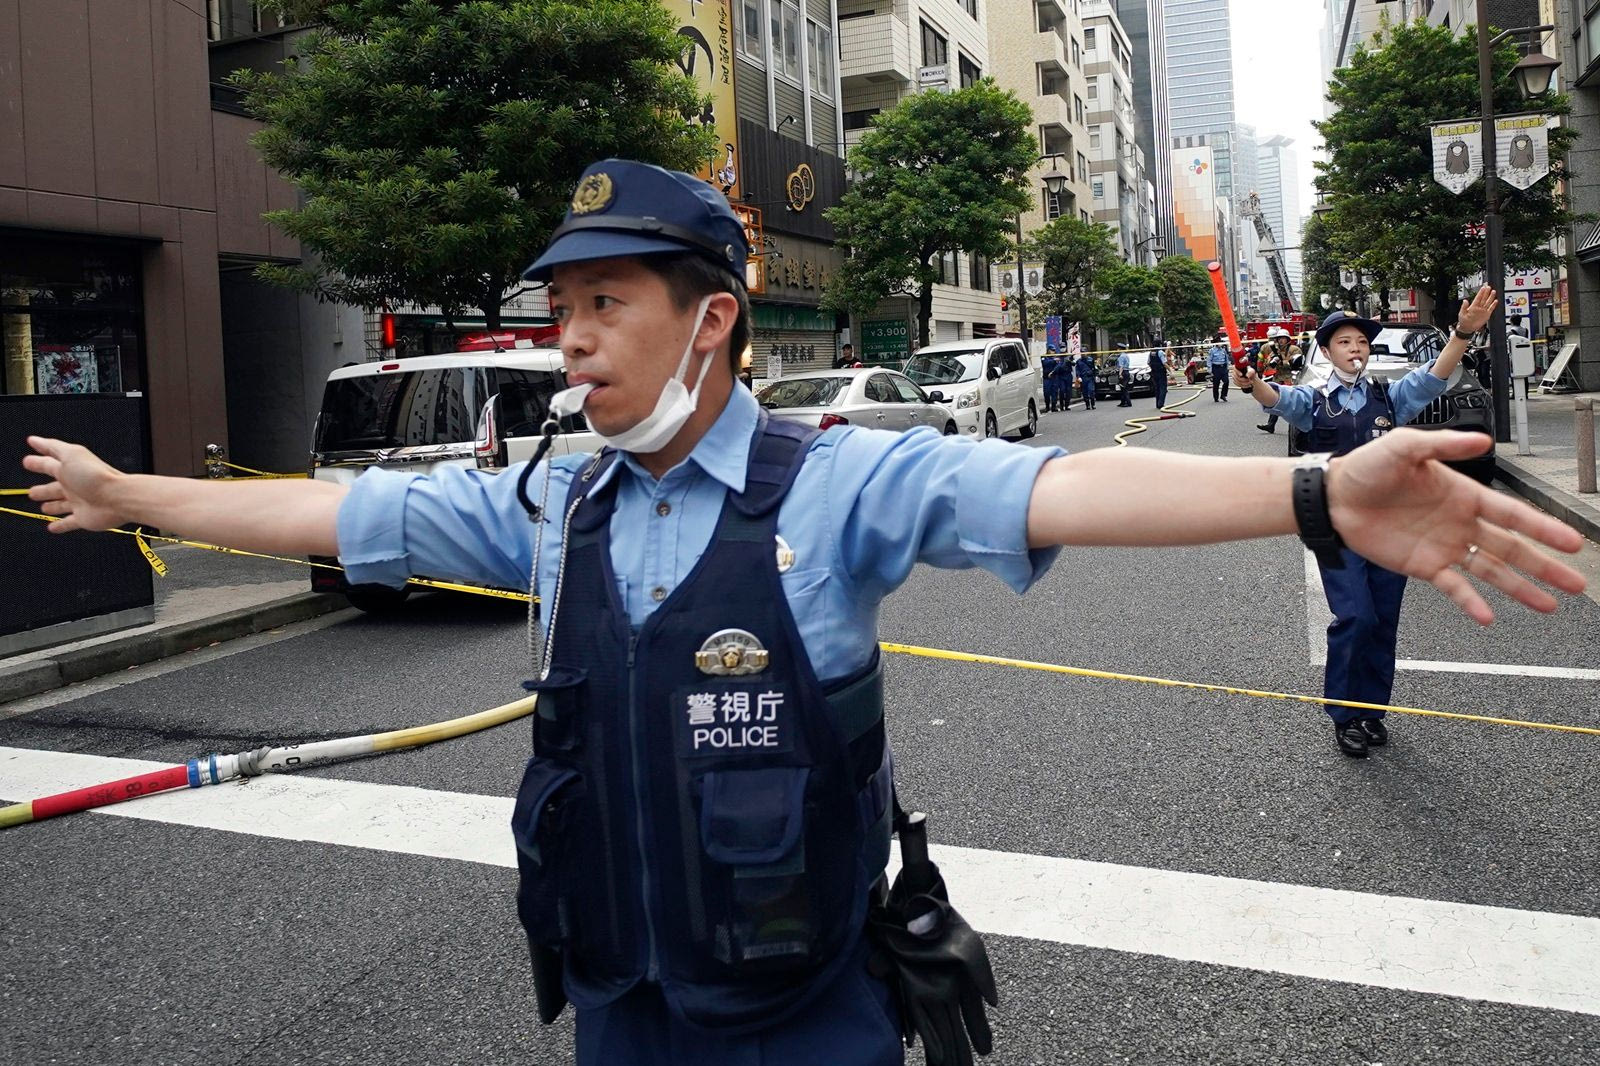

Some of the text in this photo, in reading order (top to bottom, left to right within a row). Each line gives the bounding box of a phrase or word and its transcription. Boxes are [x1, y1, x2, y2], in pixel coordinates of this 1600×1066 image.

[687, 690, 784, 725] 警視庁
[694, 726, 779, 749] POLICE
